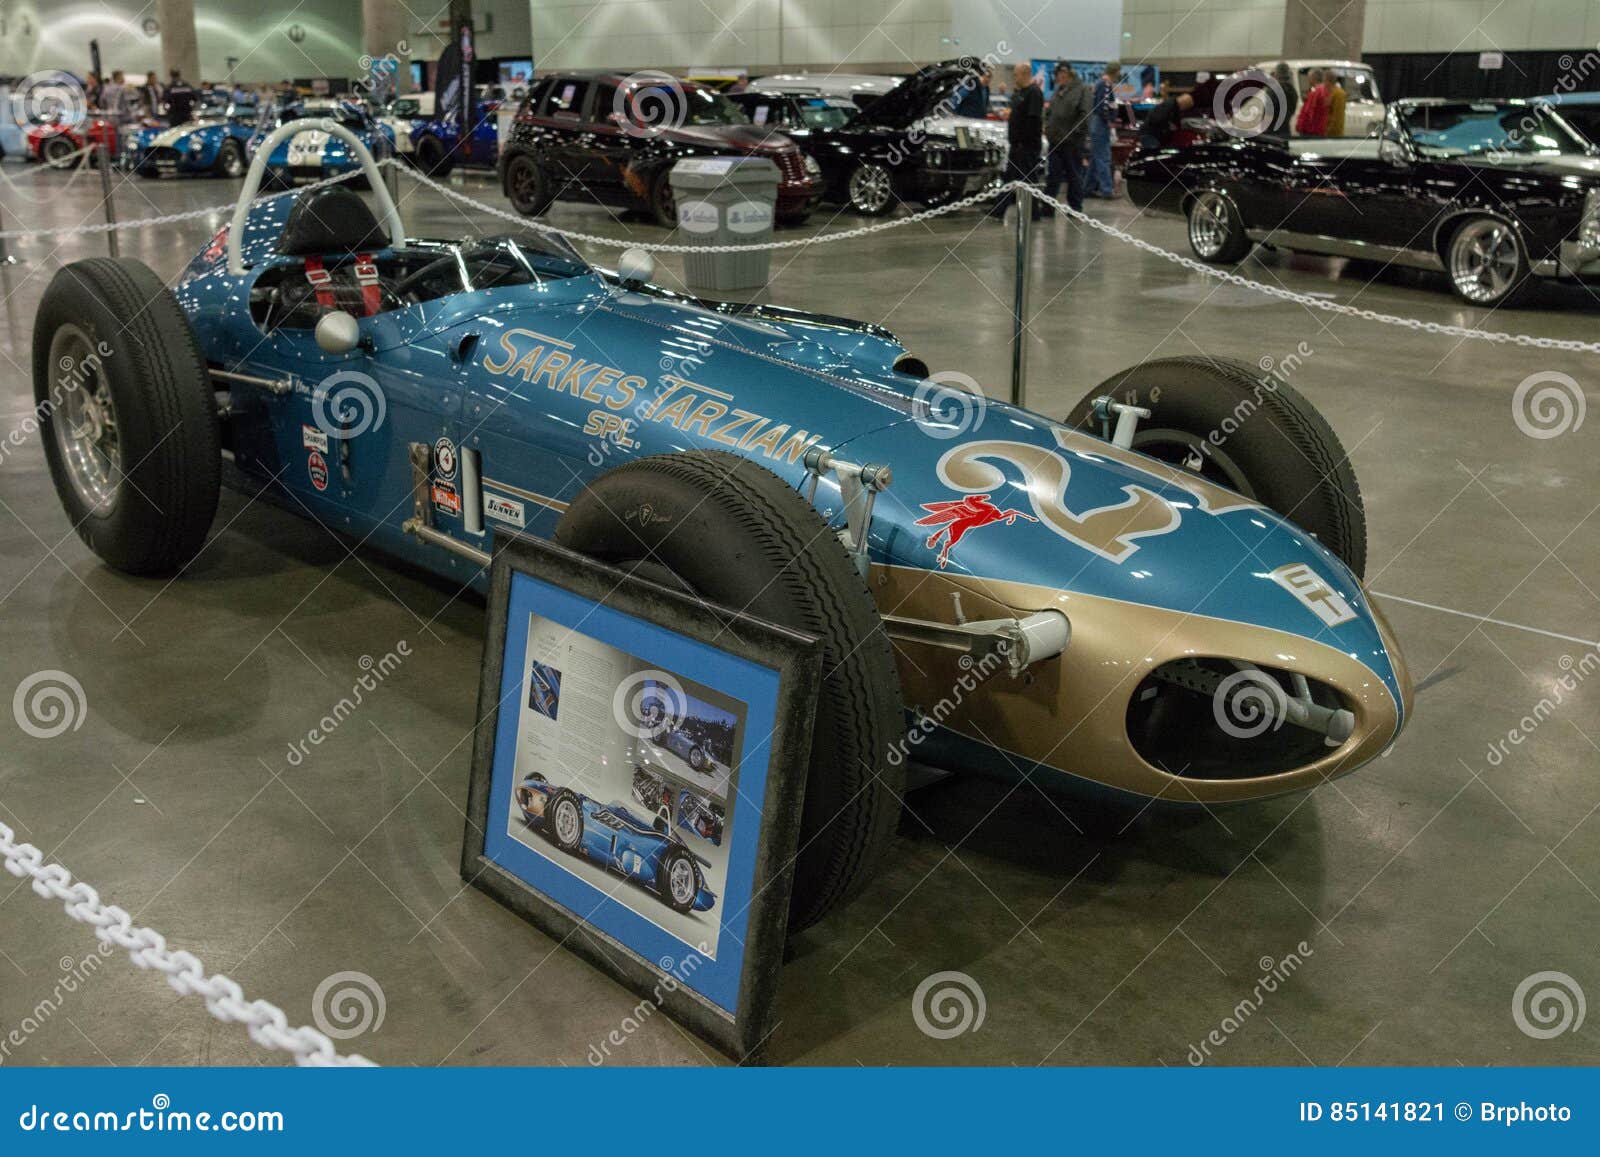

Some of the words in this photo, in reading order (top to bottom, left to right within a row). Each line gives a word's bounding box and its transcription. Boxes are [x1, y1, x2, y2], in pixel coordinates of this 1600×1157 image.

[483, 328, 648, 410] SARKES
[583, 410, 641, 449] SPL.
[643, 374, 824, 465] TARZIAN
[936, 440, 1181, 565] 2
